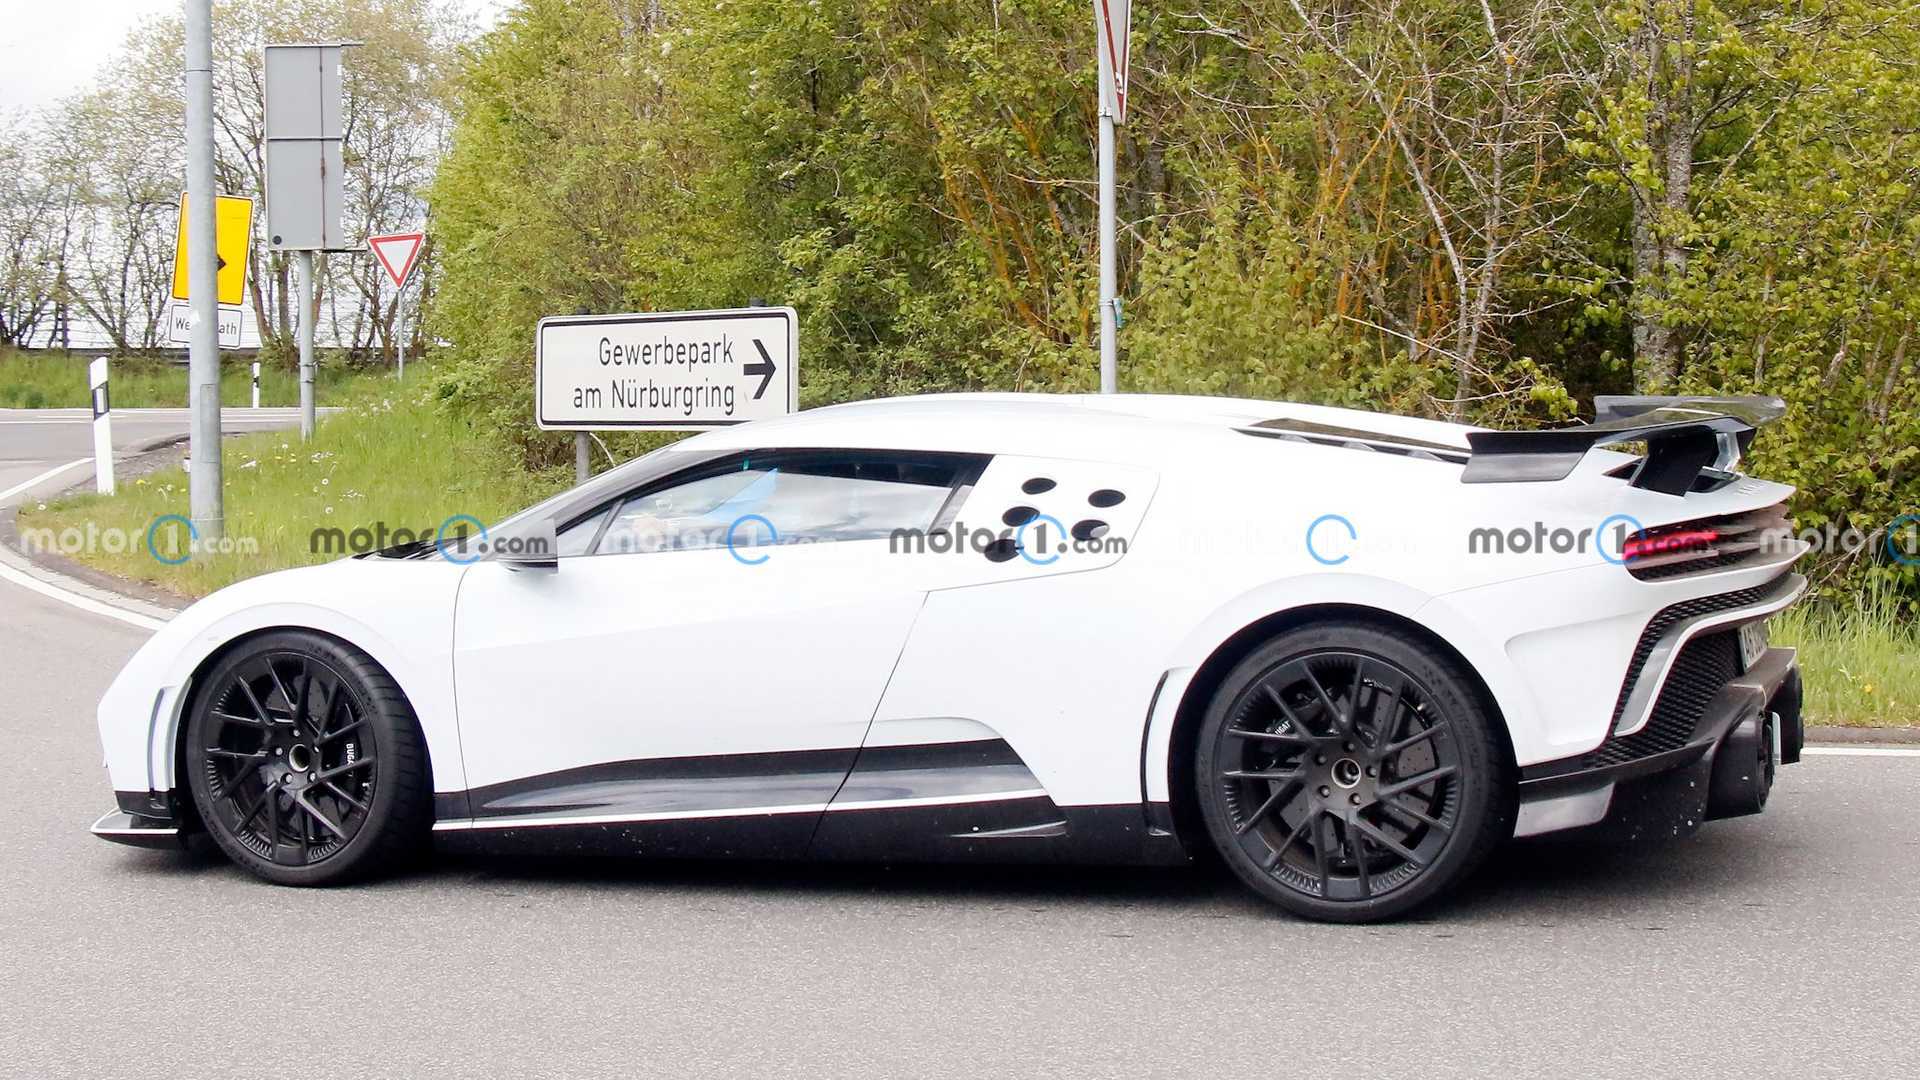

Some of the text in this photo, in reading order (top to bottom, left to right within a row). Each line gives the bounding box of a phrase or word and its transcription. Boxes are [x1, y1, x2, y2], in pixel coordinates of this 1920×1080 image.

[175, 316, 237, 335] Weath
[599, 333, 734, 372] Gewerbepark
[573, 378, 735, 416] am Nürburgring
